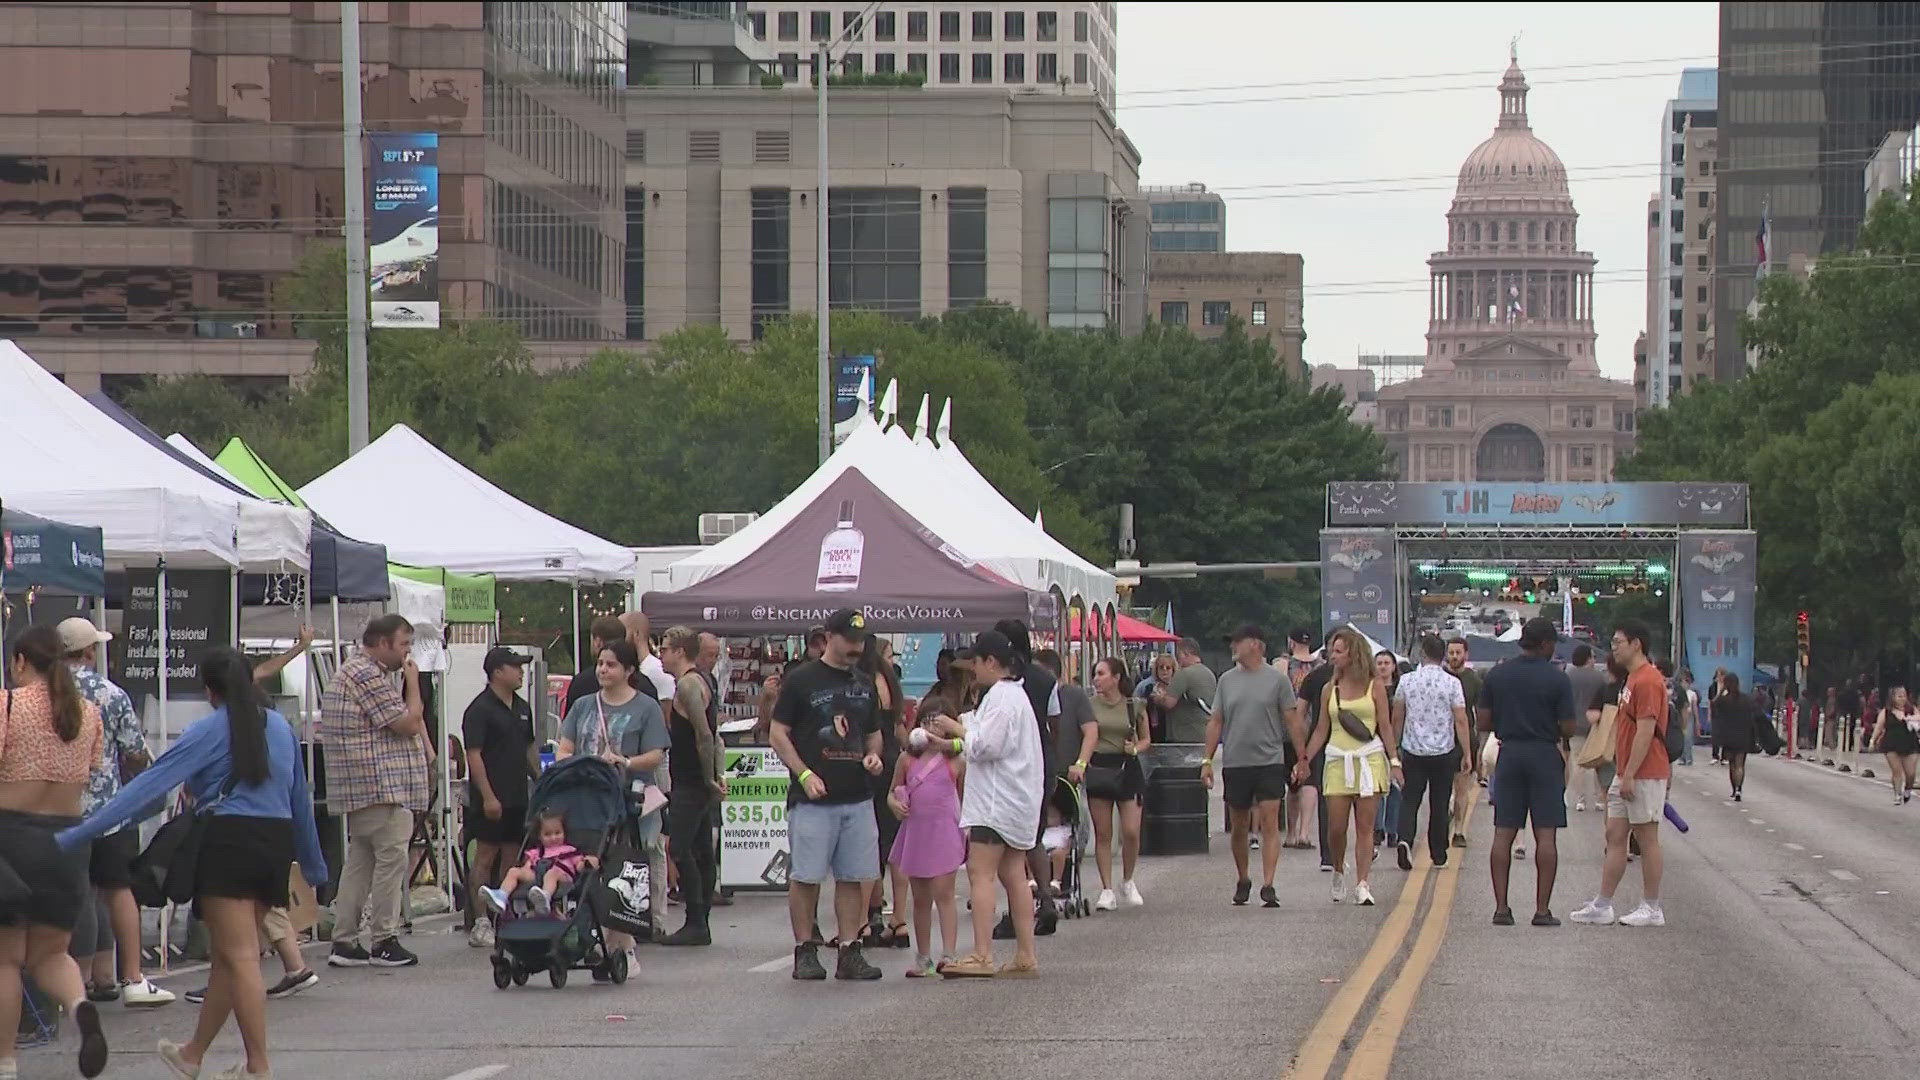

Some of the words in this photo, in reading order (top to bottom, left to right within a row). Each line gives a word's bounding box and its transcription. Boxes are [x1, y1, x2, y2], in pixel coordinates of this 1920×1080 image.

[1442, 489, 1489, 514] TJH
[829, 554, 852, 562] ROCK
[129, 625, 151, 642] Fast,
[152, 626, 209, 642] poessional
[127, 644, 176, 658] installaon
[177, 645, 186, 659] is
[1698, 634, 1738, 656] TJH
[125, 663, 156, 680] always
[157, 664, 197, 678] cluded
[727, 785, 762, 796] ENTER
[766, 785, 779, 796] TO
[724, 829, 760, 838] WINDOW
[761, 829, 768, 838] &
[769, 829, 787, 838] DOO
[724, 841, 771, 850] MAKEOVER
